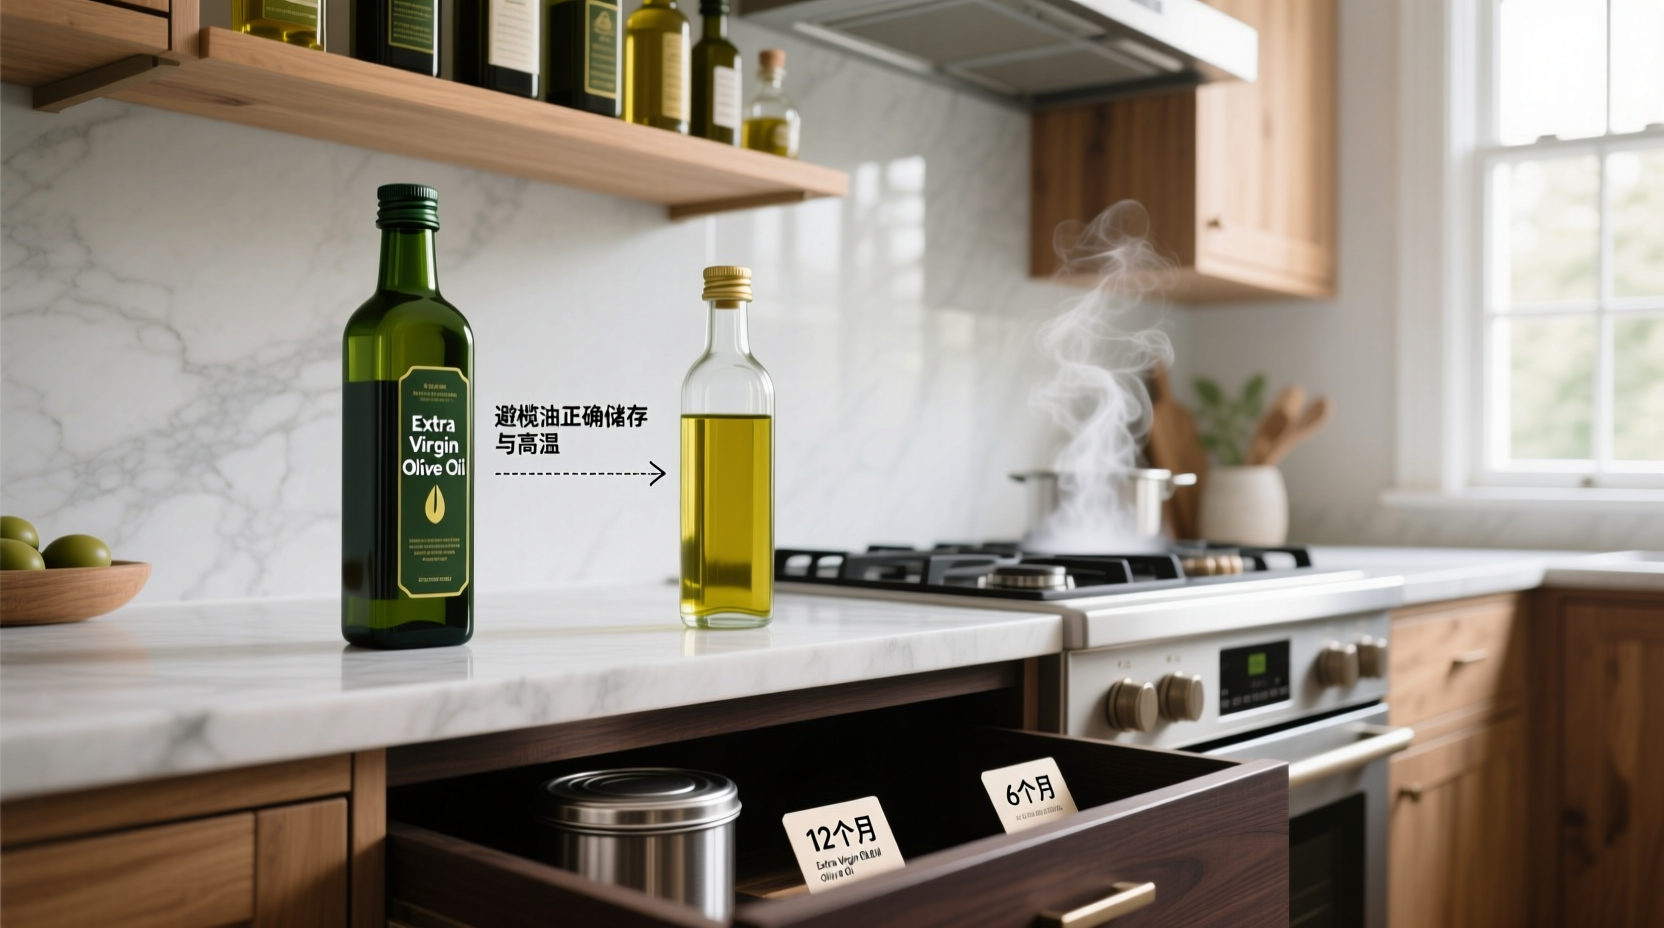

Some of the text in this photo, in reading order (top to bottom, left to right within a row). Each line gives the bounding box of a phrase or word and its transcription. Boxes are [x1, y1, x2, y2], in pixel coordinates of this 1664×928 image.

[412, 415, 456, 432] Extra
[409, 435, 459, 458] Virgin
[402, 458, 443, 476] Olive
[1006, 774, 1055, 806] 6个月
[806, 815, 877, 852] 12个月
